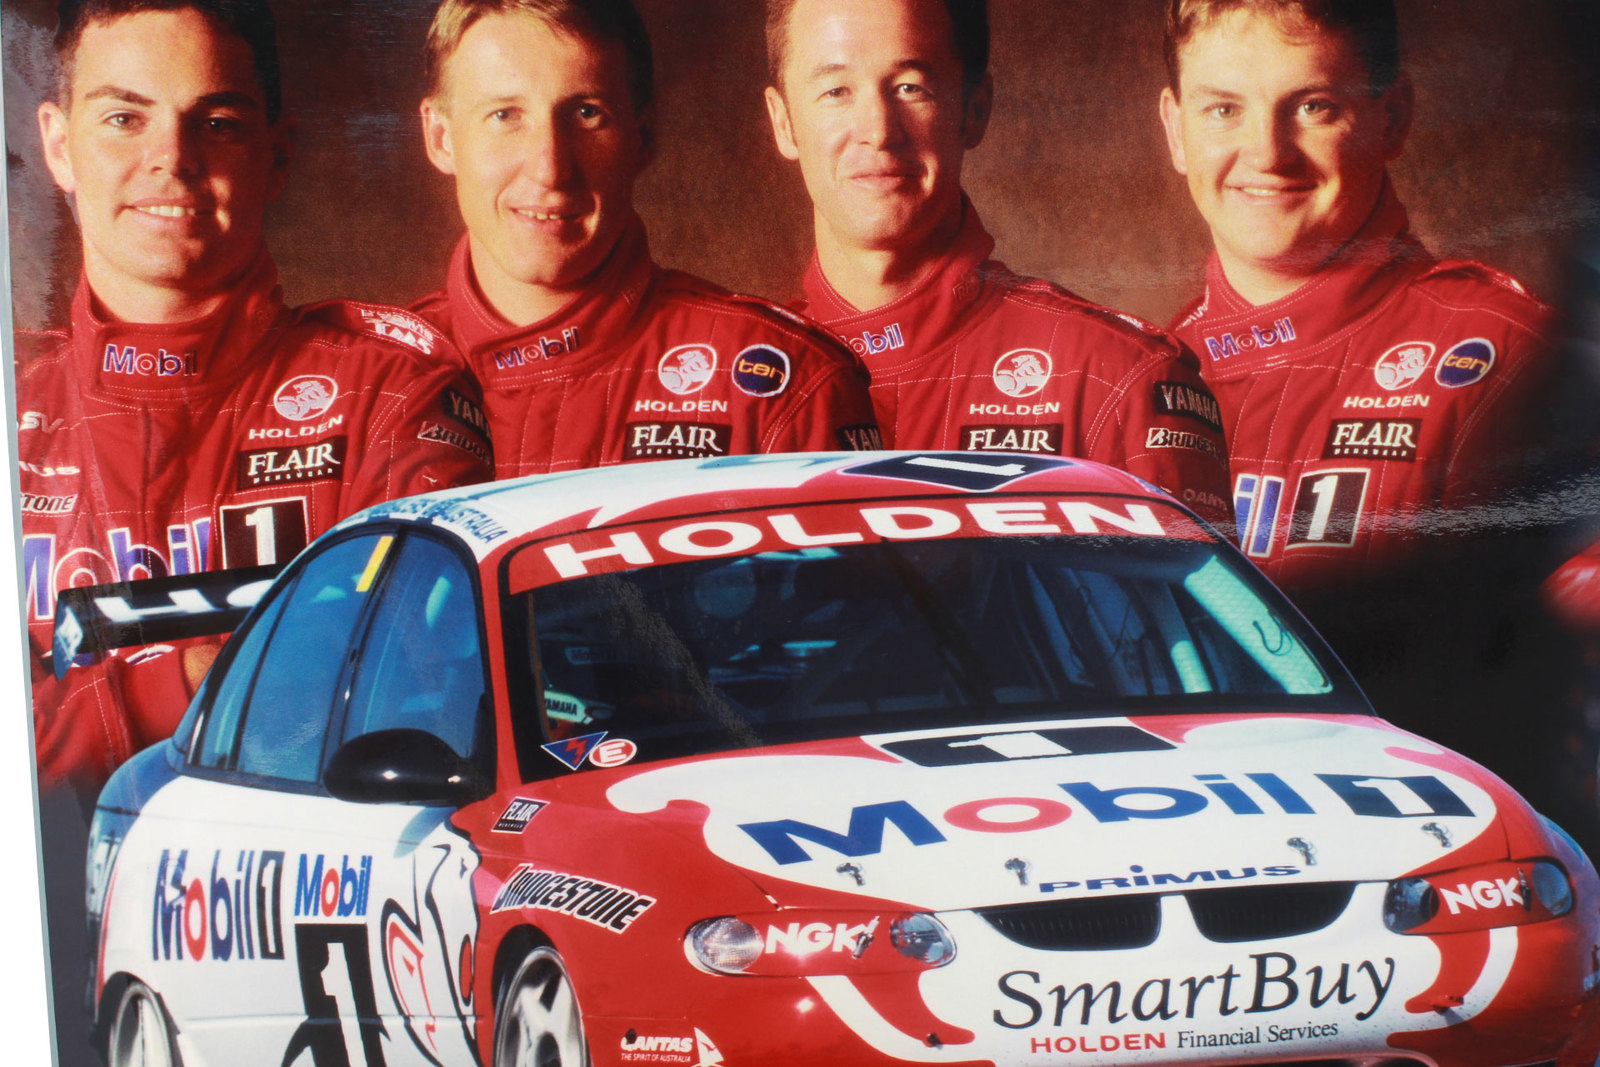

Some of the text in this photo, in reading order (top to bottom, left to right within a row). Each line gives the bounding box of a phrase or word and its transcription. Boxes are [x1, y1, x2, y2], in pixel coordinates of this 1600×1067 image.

[495, 327, 580, 369] Mobil
[842, 323, 904, 358] obil
[1205, 317, 1297, 361] Mobil
[103, 343, 198, 376] Mobil
[738, 358, 786, 384] ten
[1444, 354, 1488, 374] ten
[634, 399, 728, 413] HOLDEN
[969, 402, 1061, 416] HOLDEN
[1161, 384, 1219, 426] YAMAHA
[1343, 394, 1430, 408] HOLDEN
[17, 411, 64, 433] SV
[248, 414, 343, 439] HOLDEN
[632, 424, 723, 452] FLAIR
[1332, 422, 1416, 448] FLAIR
[967, 429, 1057, 451] FLAIR
[247, 443, 341, 476] FLAIR
[1308, 474, 1338, 541] 1
[245, 506, 277, 566] 1
[543, 501, 1167, 579] HOLDEN
[601, 742, 627, 764] E
[949, 730, 1074, 757] 1
[501, 801, 540, 822] FLAIR
[735, 773, 1413, 866] Mobil 1
[295, 854, 372, 917] Mobil
[490, 864, 655, 933] BRIDGESTONE
[1440, 877, 1524, 915] NGK
[152, 849, 282, 961] Mobil 1
[765, 922, 862, 954] NGK
[320, 942, 366, 1067] 1
[993, 951, 1394, 1030] SmartBuy
[1030, 1021, 1338, 1054] HOLDEN Financial Services
[621, 1053, 691, 1062] THE SPIRIT OF AUSTRALIA
